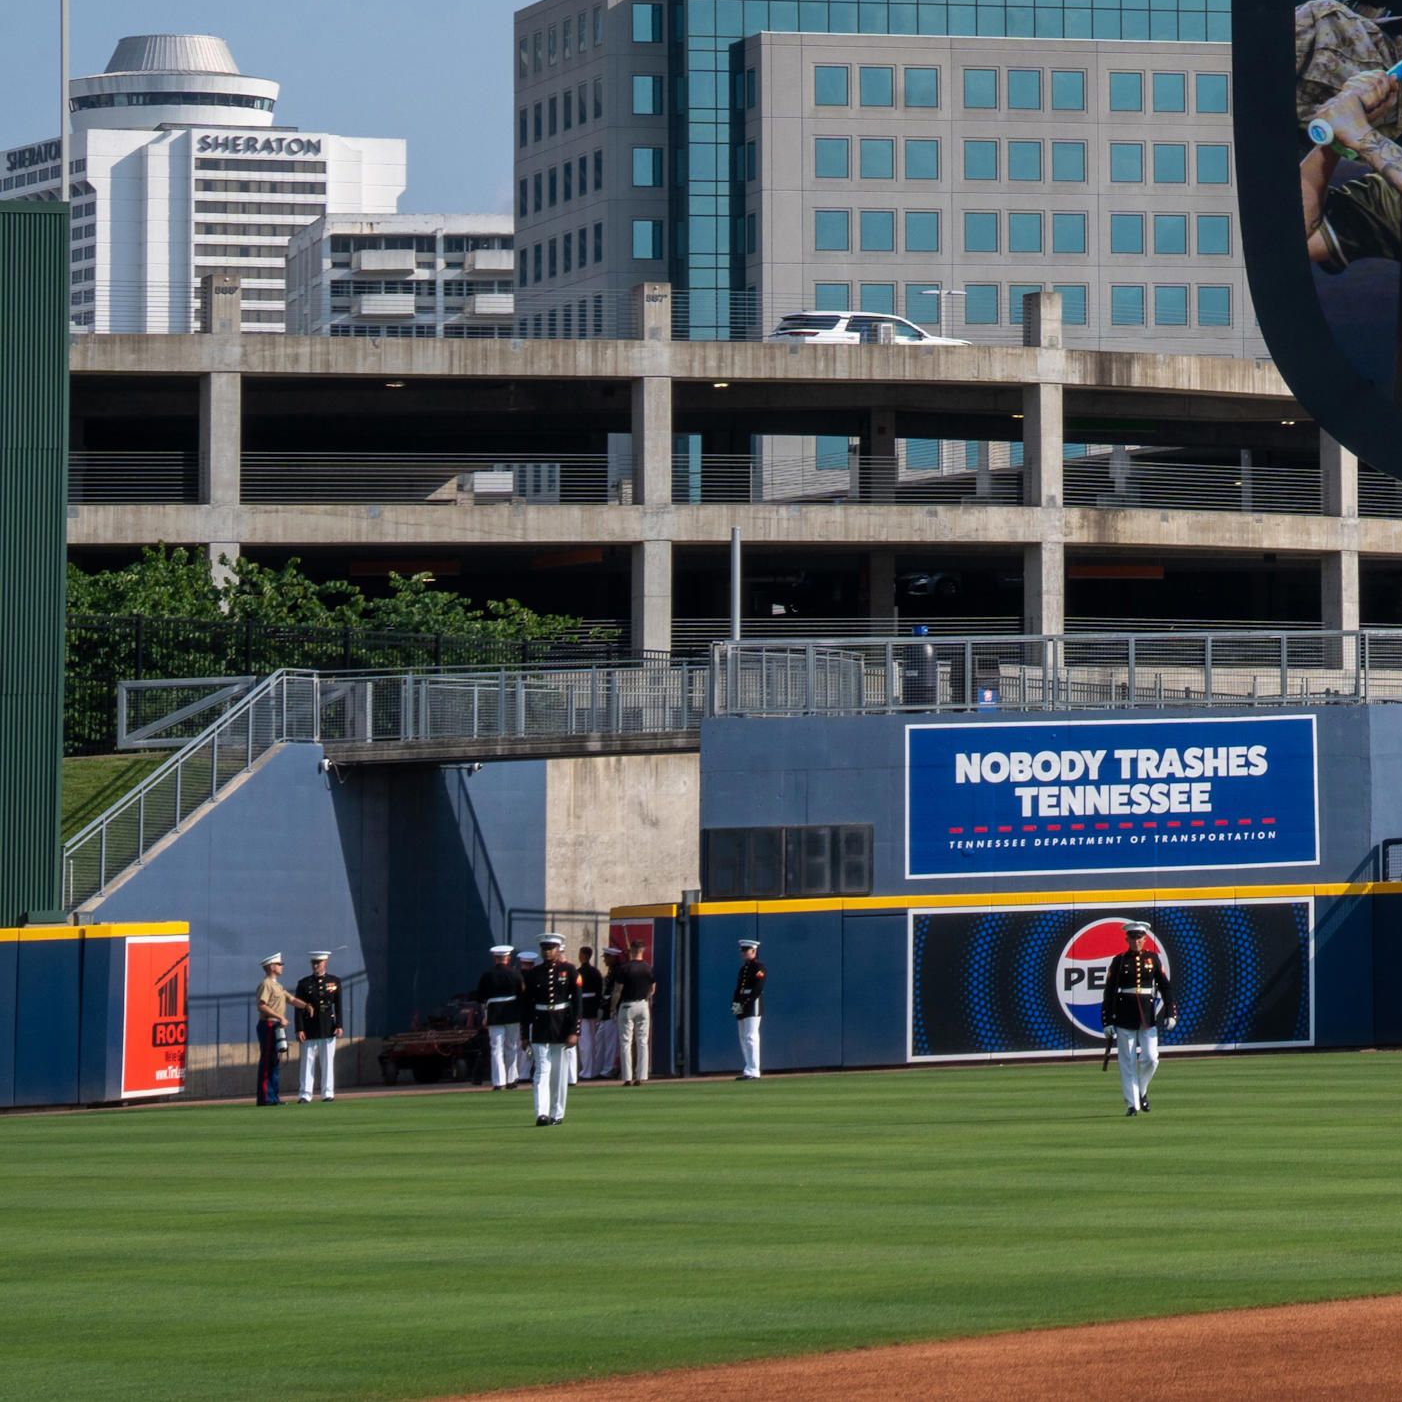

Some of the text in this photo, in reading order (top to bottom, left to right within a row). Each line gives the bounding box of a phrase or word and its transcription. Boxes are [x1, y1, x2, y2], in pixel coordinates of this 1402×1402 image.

[197, 135, 322, 156] SHERATON
[956, 745, 1268, 783] NOBODY TRASHES
[1015, 782, 1211, 817] TENNESSEE
[949, 831, 1276, 850] TENNESSEE DEPARTMENT OF TRANSPORTATION
